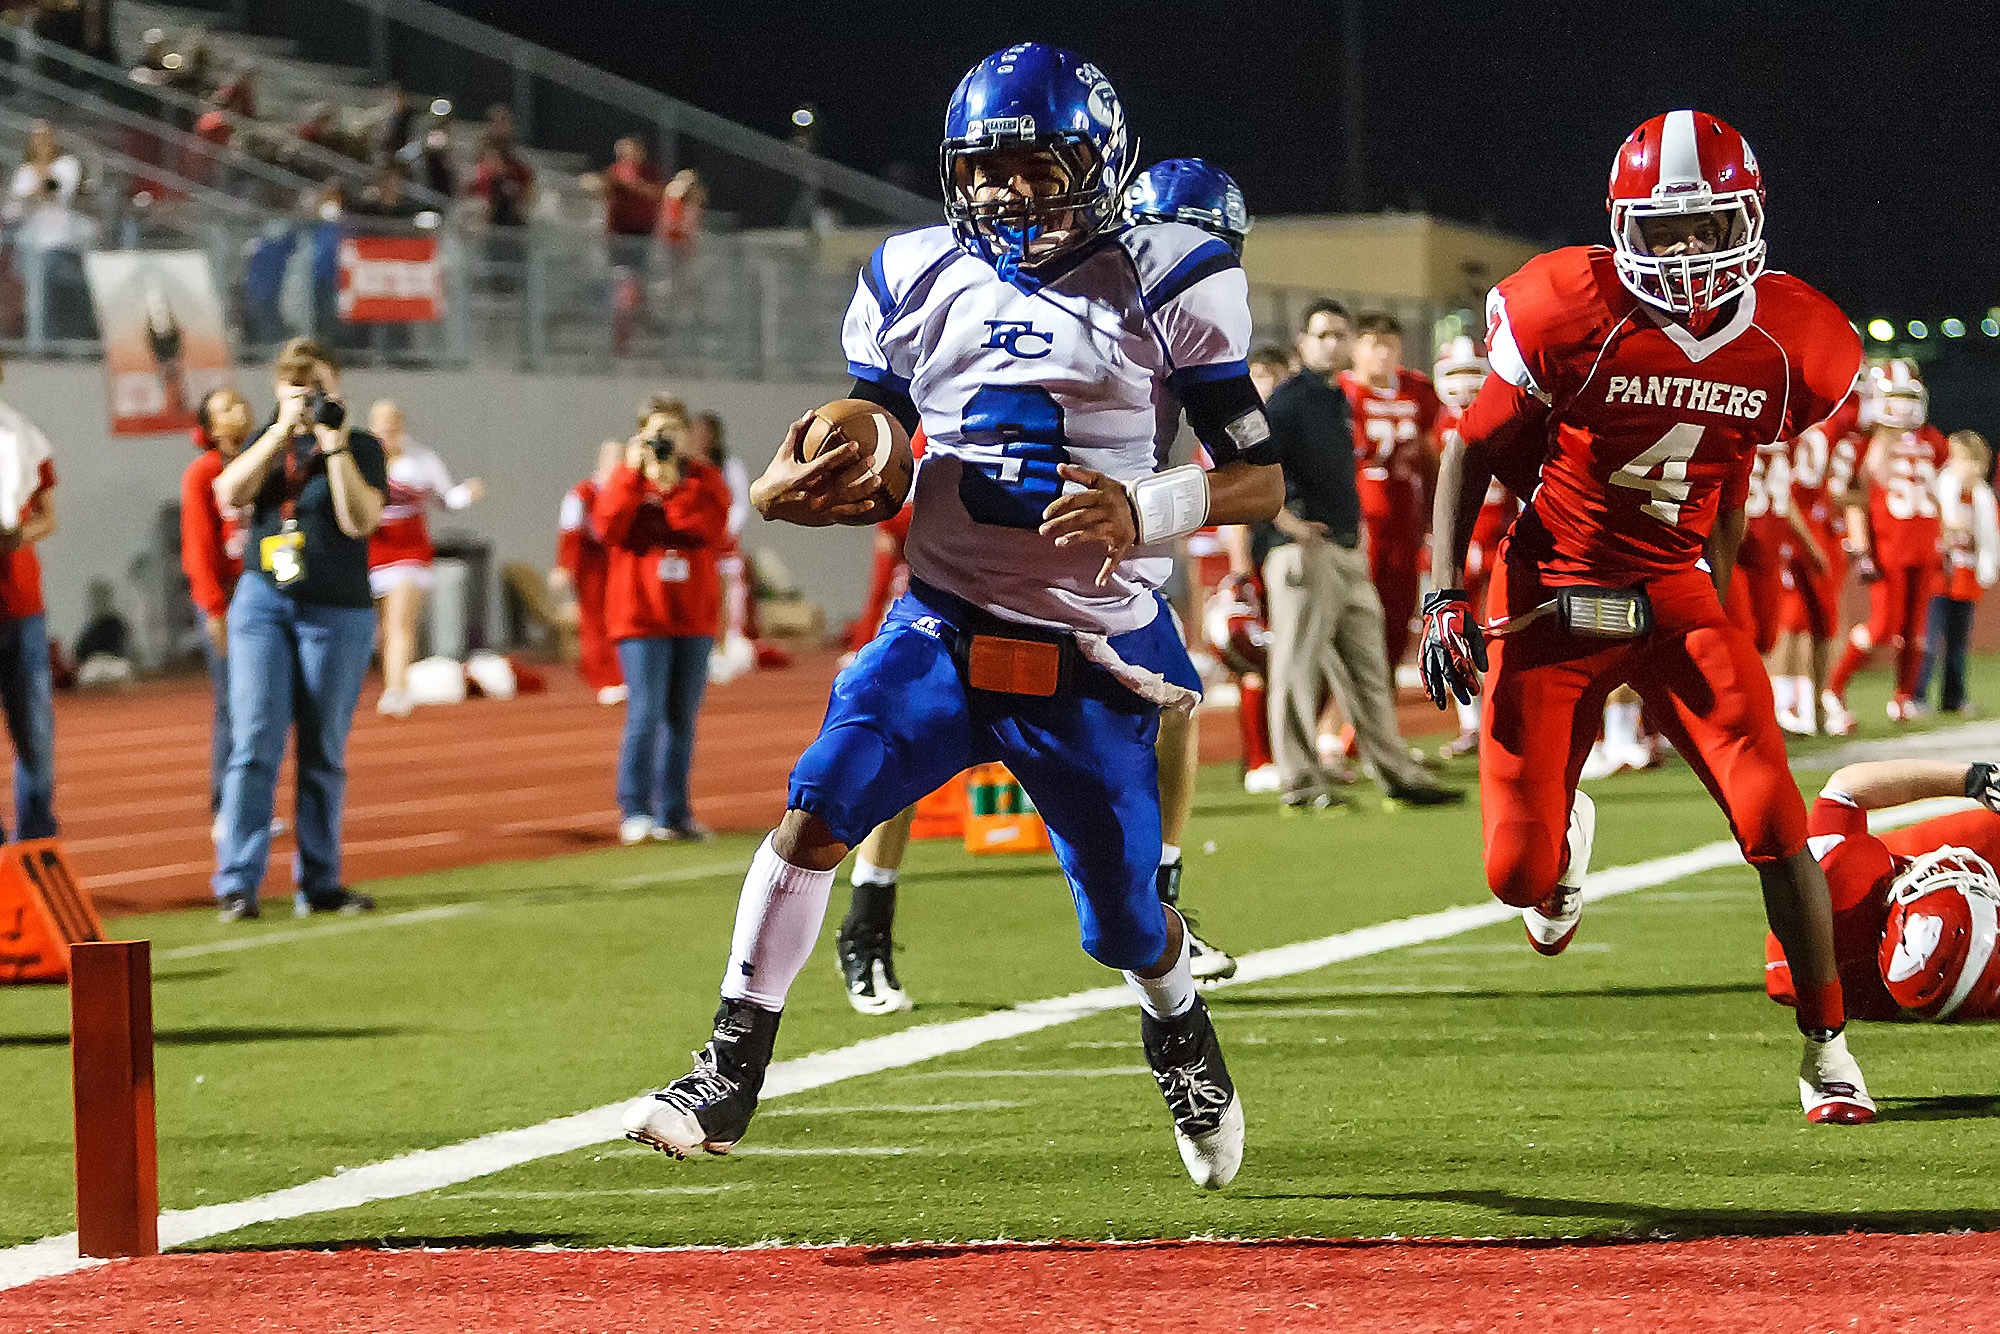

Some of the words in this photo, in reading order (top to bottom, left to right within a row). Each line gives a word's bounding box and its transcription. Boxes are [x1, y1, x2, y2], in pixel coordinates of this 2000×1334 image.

[981, 320, 1054, 360] FC
[1605, 375, 1768, 419] PANTHERS
[1608, 422, 1706, 527] 4
